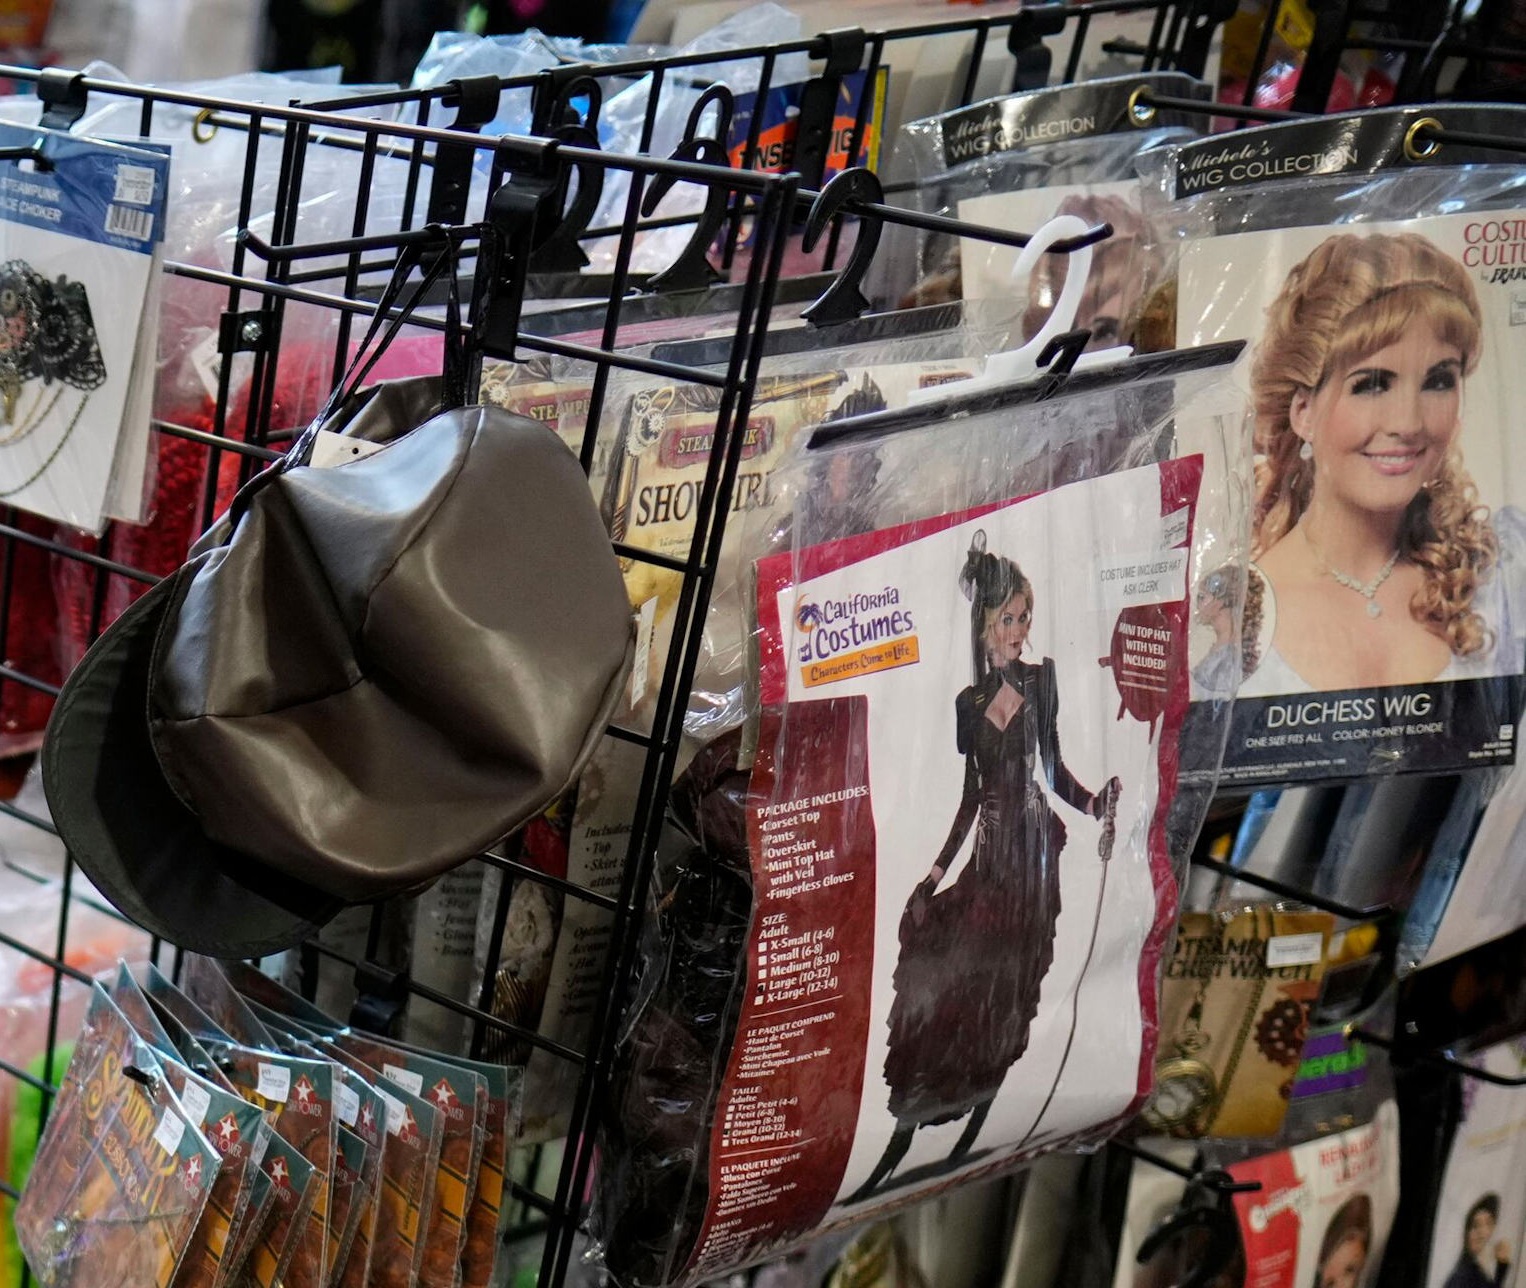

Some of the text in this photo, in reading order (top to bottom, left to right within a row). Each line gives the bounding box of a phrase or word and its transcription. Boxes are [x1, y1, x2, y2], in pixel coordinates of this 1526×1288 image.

[951, 117, 1095, 158] WIG COLLECTION
[1183, 140, 1272, 171] Michele's
[1182, 149, 1358, 190] WIG COLLECTION
[0, 177, 62, 201] STEAMPUNK
[19, 201, 63, 222] CHOKER
[1464, 220, 1526, 244] COSTU
[1463, 243, 1526, 267] CULTU
[530, 399, 591, 420] STEAMPU
[677, 427, 760, 454] STEAK
[636, 471, 777, 526] SHOIRL
[1100, 564, 1136, 581] COSTUME
[1168, 559, 1182, 572] HAT
[1123, 580, 1159, 595] ASK CLERK
[1119, 622, 1171, 642] MINI TOP HAT
[1126, 639, 1165, 656] WITH VEIL
[1123, 653, 1166, 669] INCLUDED!
[1267, 693, 1432, 728] DUCHESS WIG
[1246, 721, 1444, 748] ONE SIZE FITS ALL COLOR: HONEY BLONDE
[757, 785, 869, 818] PACKAGE INCLUDES:
[762, 811, 820, 831] Corset Top
[766, 831, 795, 845] Pants
[767, 840, 816, 858] Overskirt
[768, 848, 834, 872] Mini Top Hat
[769, 872, 855, 900] Fingerless Gloves
[771, 867, 814, 886] with Veil
[762, 913, 788, 927] SIZE:
[758, 925, 789, 940] Adult
[770, 926, 835, 950] X-Small (4-6)
[770, 943, 823, 964] Small (6-8)
[770, 951, 840, 977] Medium (8-10)
[766, 978, 838, 1004] X-Large (12-14)
[769, 967, 831, 991] Large (10-12)
[747, 1012, 835, 1037] LE PAQUET COMPREND
[770, 1033, 779, 1042] de
[780, 1029, 804, 1040] Corset
[746, 1043, 781, 1053] Pantalon
